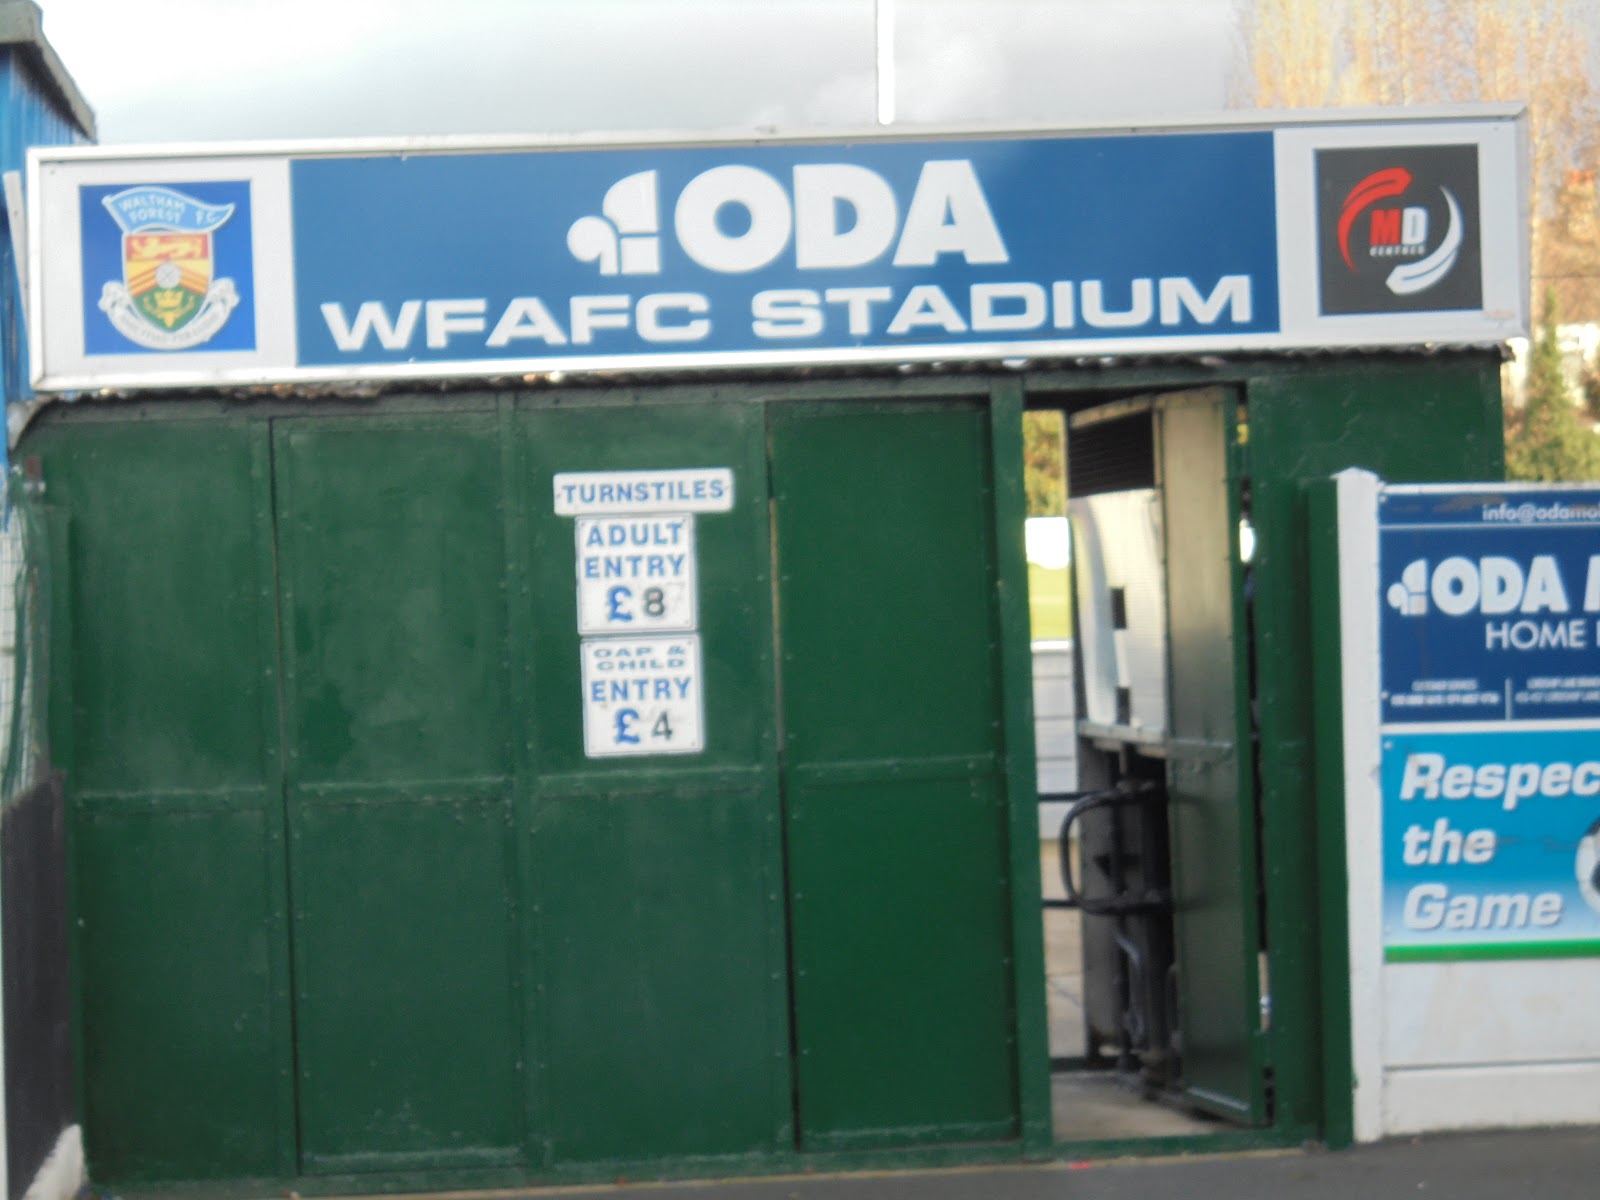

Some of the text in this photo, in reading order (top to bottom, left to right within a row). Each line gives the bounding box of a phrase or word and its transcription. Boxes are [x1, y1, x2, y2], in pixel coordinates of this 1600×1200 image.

[674, 159, 1009, 273] ODA
[1369, 207, 1428, 246] MD
[320, 275, 1253, 352] WFAFC STADIUM
[562, 479, 726, 504] TURNSTILES
[1482, 502, 1600, 521] info@odamo
[586, 522, 684, 548] ADULT
[585, 553, 686, 579] ENTRY
[1431, 556, 1569, 616] ODA
[1485, 619, 1587, 650] HOME
[594, 644, 686, 658] OAP &
[597, 658, 686, 671] CHILD
[591, 676, 692, 703] ENTRY
[1403, 816, 1498, 866] the
[1403, 882, 1564, 931] Game
